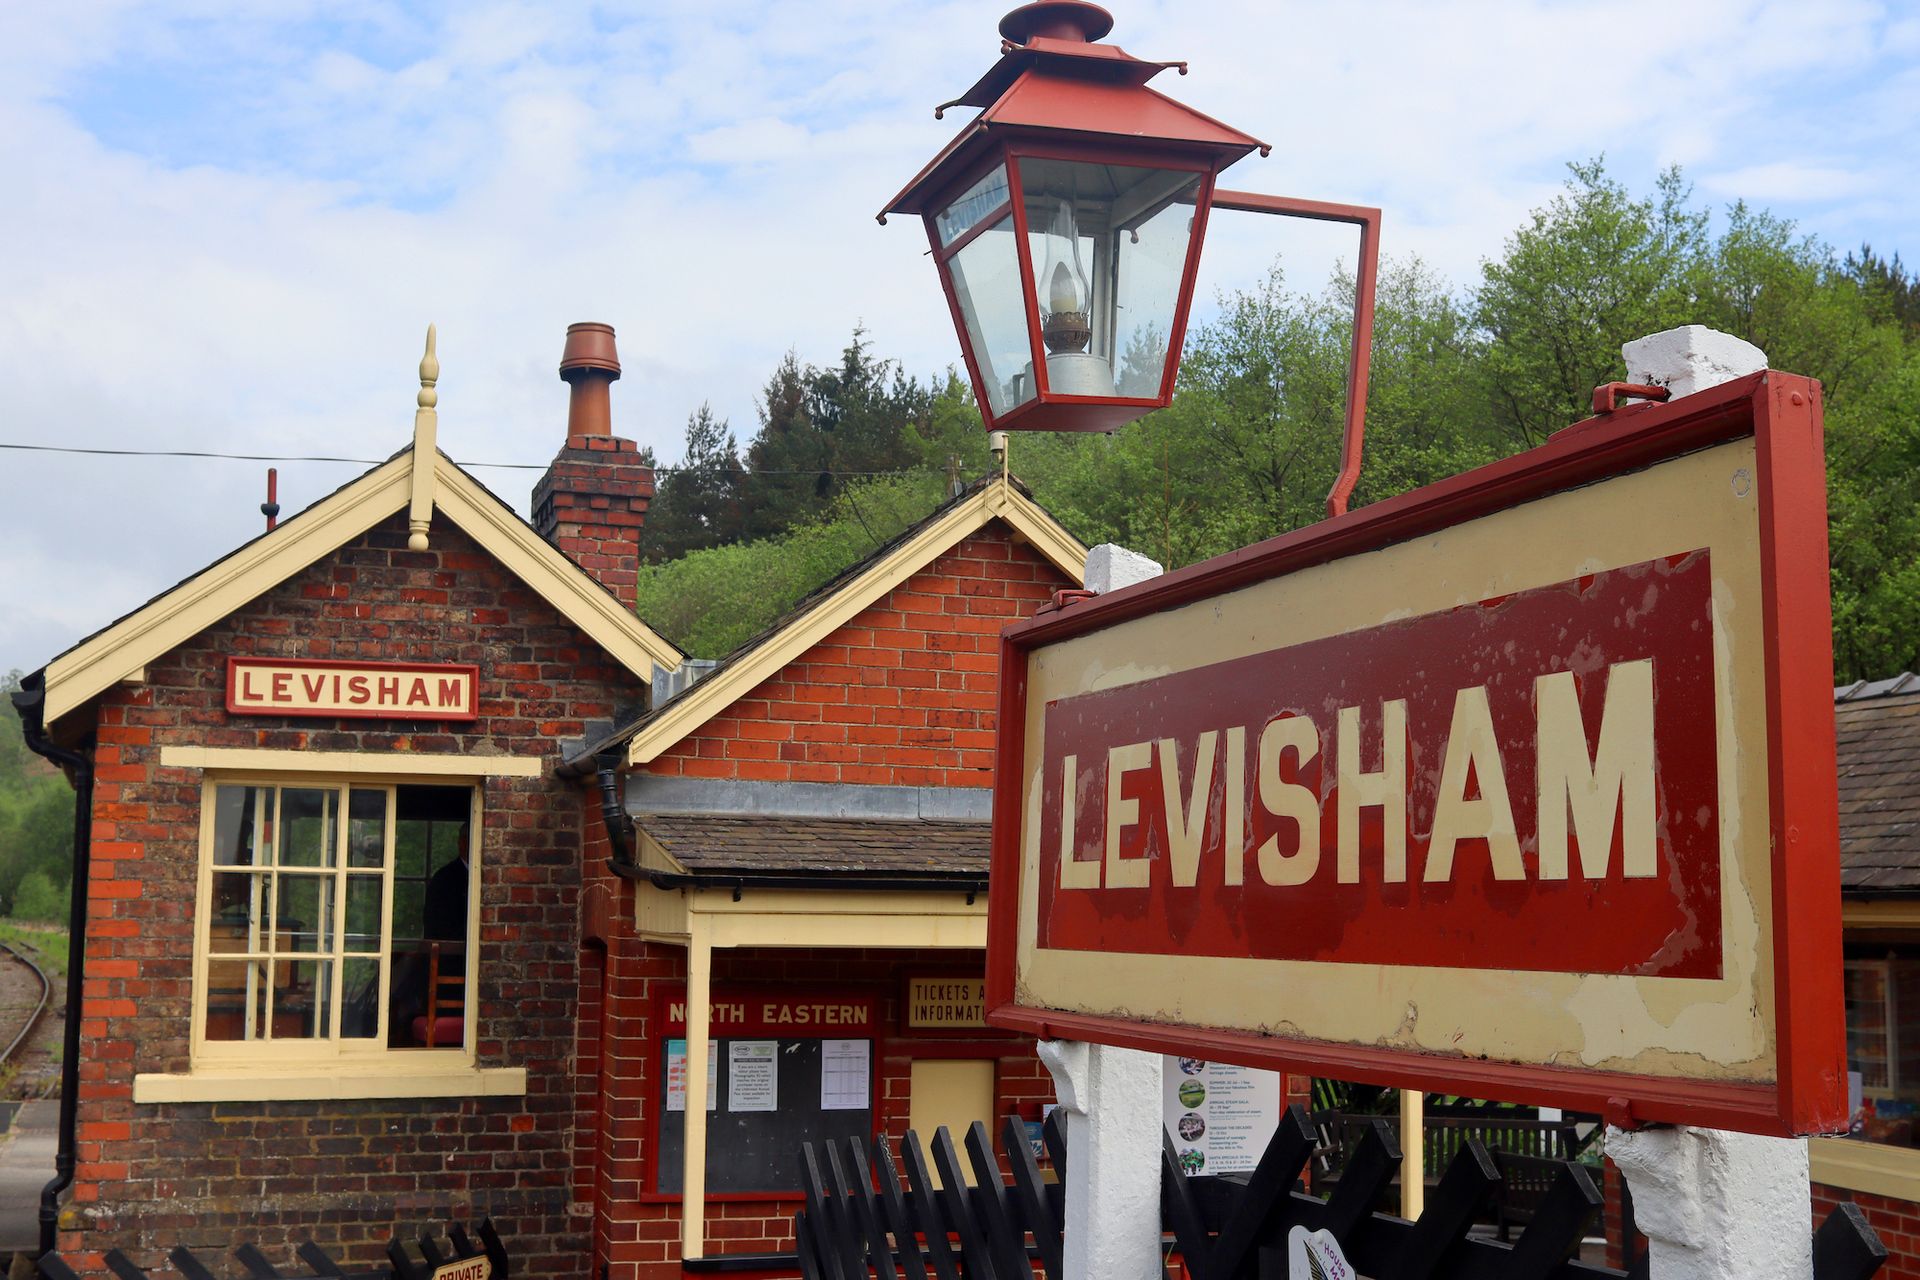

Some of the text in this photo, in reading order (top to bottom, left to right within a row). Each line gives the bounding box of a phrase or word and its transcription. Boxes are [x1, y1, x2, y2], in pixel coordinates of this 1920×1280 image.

[243, 671, 461, 707] LEVISHAM
[1060, 657, 1657, 890] LEVISHAM
[916, 984, 969, 1001] TICKETS
[669, 1003, 868, 1025] NTH EASTERN
